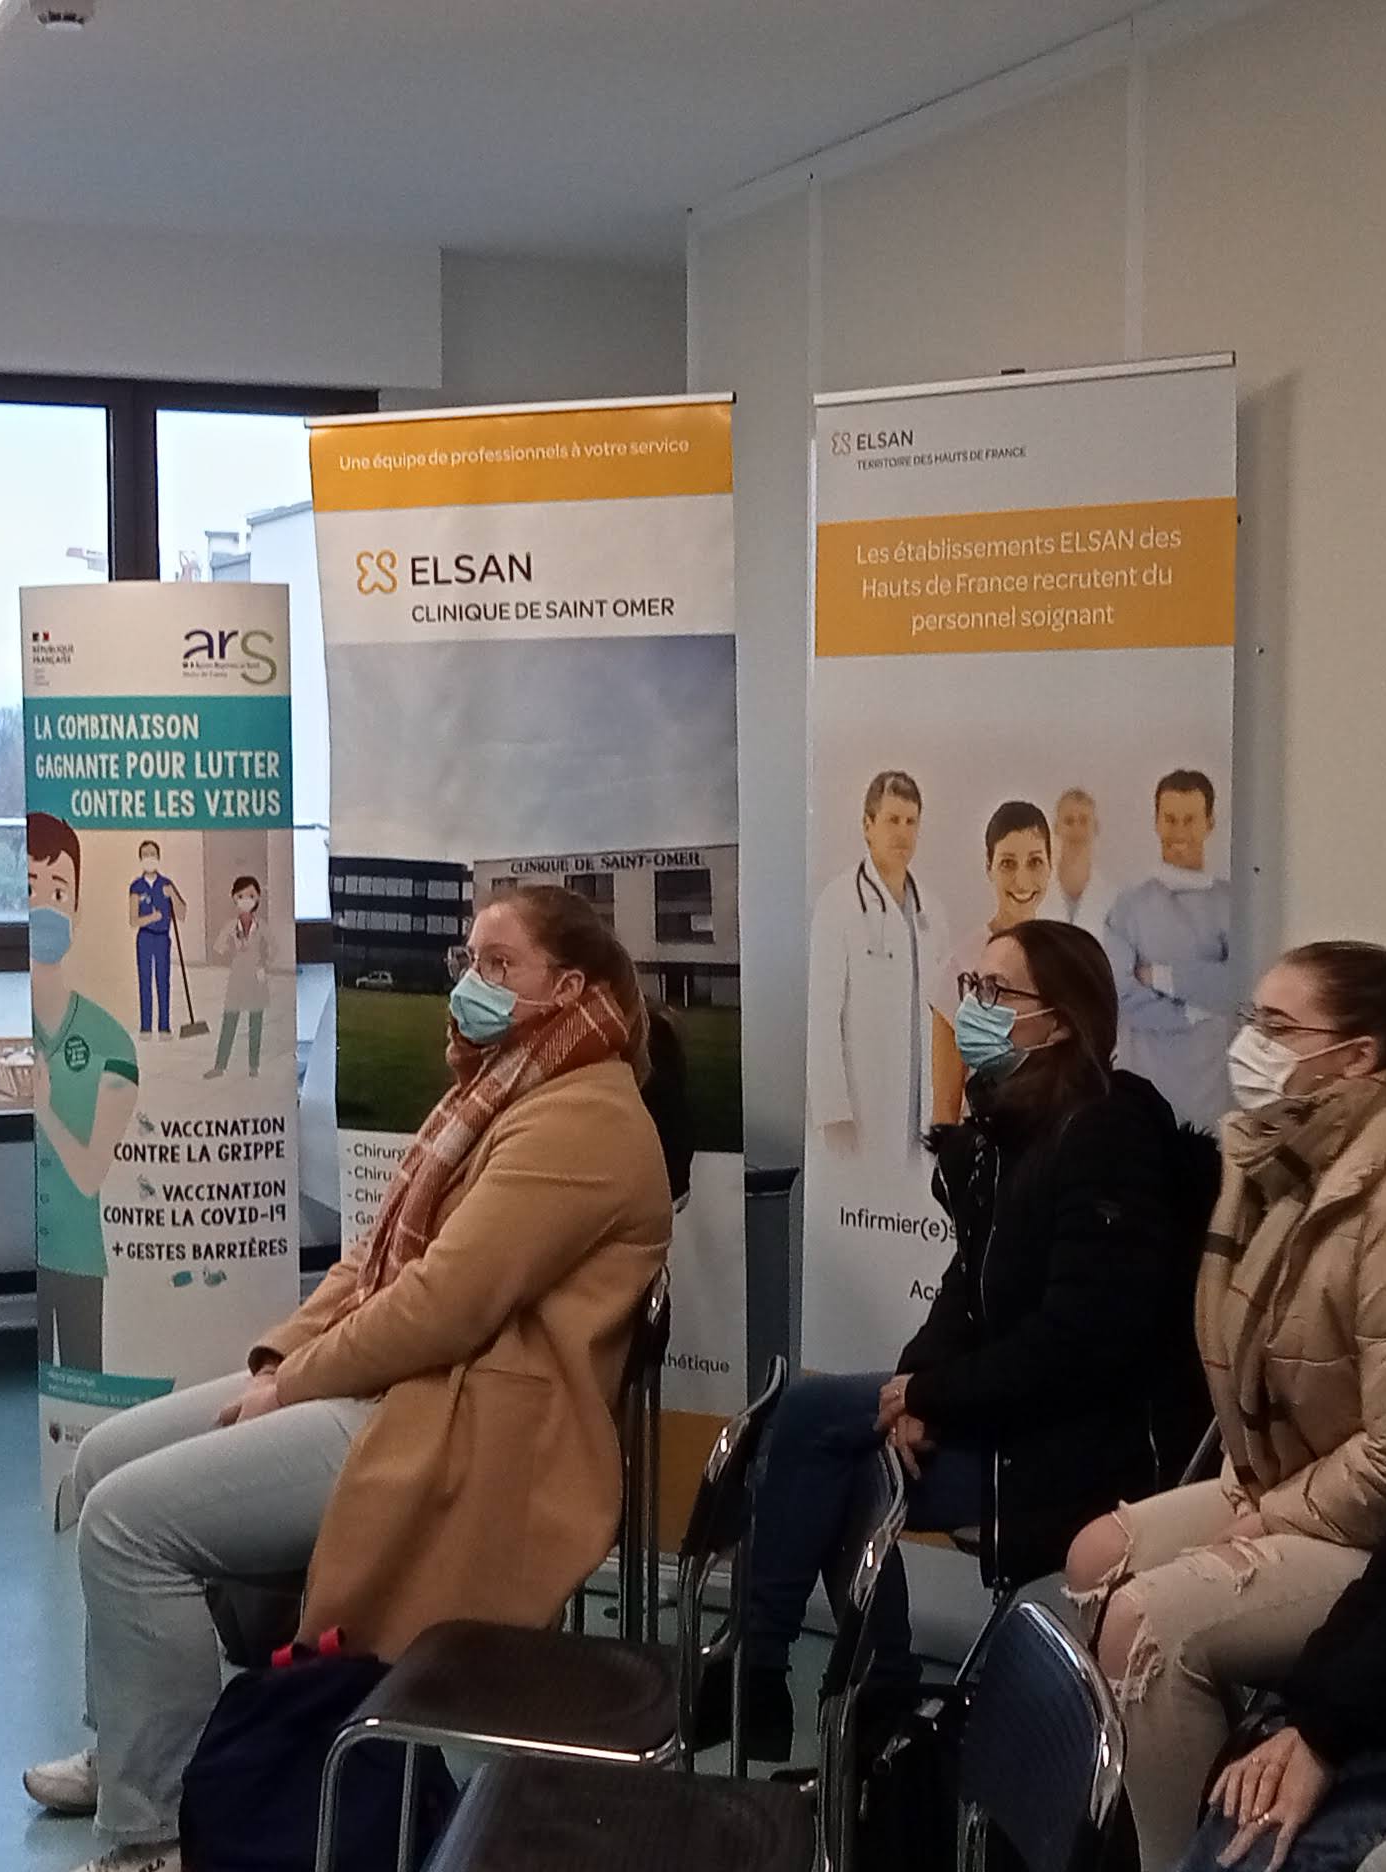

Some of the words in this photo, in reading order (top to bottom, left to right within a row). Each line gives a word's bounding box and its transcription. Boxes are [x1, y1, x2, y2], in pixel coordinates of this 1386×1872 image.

[856, 430, 913, 450] ELSAN
[339, 455, 370, 472] Une
[373, 453, 426, 473] équipe
[428, 449, 449, 466] de
[451, 444, 568, 470] professionnels
[570, 443, 581, 459] à
[584, 442, 628, 459] votre
[629, 437, 690, 456] service
[857, 456, 911, 471] TERRITOIRE
[913, 454, 933, 465] DES
[934, 452, 968, 464] HAUTS
[969, 451, 983, 462] DE
[985, 446, 1027, 460] FRANCE
[857, 545, 889, 565] Les
[893, 535, 1055, 562] établissements
[1060, 528, 1134, 554] ELSAN
[1139, 526, 1182, 549] des
[411, 552, 533, 586] ELSAN
[862, 577, 921, 599] Hauts
[925, 574, 951, 597] de
[956, 570, 1028, 595] France
[1033, 566, 1137, 591] recrutent
[1142, 563, 1173, 586] du
[412, 602, 511, 624] CLINIQUE
[515, 602, 542, 620] DE
[546, 600, 608, 619] SAINT
[612, 598, 675, 618] OMER
[912, 605, 1016, 636] personnel
[1021, 603, 1115, 633] soignant
[182, 629, 278, 685] ars
[34, 715, 52, 740] LA
[57, 713, 199, 741] COMBINAISON
[36, 754, 119, 780] GAGNANTE
[126, 752, 186, 779] POUR
[194, 750, 279, 779] LUTTER
[71, 790, 146, 818] CONTRE
[155, 790, 195, 818] LES
[205, 789, 281, 817] VIRUS
[510, 859, 568, 874] CLINIQUE
[575, 857, 594, 871] DE
[601, 851, 700, 869] SAINT-OMER
[161, 1116, 285, 1138] VACCINATION
[114, 1143, 180, 1163] CONTRE
[187, 1143, 211, 1163] LA
[218, 1140, 285, 1162] GRIPPE
[162, 1179, 286, 1202] VACCINATION
[103, 1208, 165, 1227] CONTRE
[171, 1208, 194, 1227] LA
[201, 1203, 287, 1226] COVID-19
[126, 1242, 186, 1262] GESTES
[192, 1237, 288, 1261] BARRIÈRES
[663, 1353, 730, 1375] hétique
